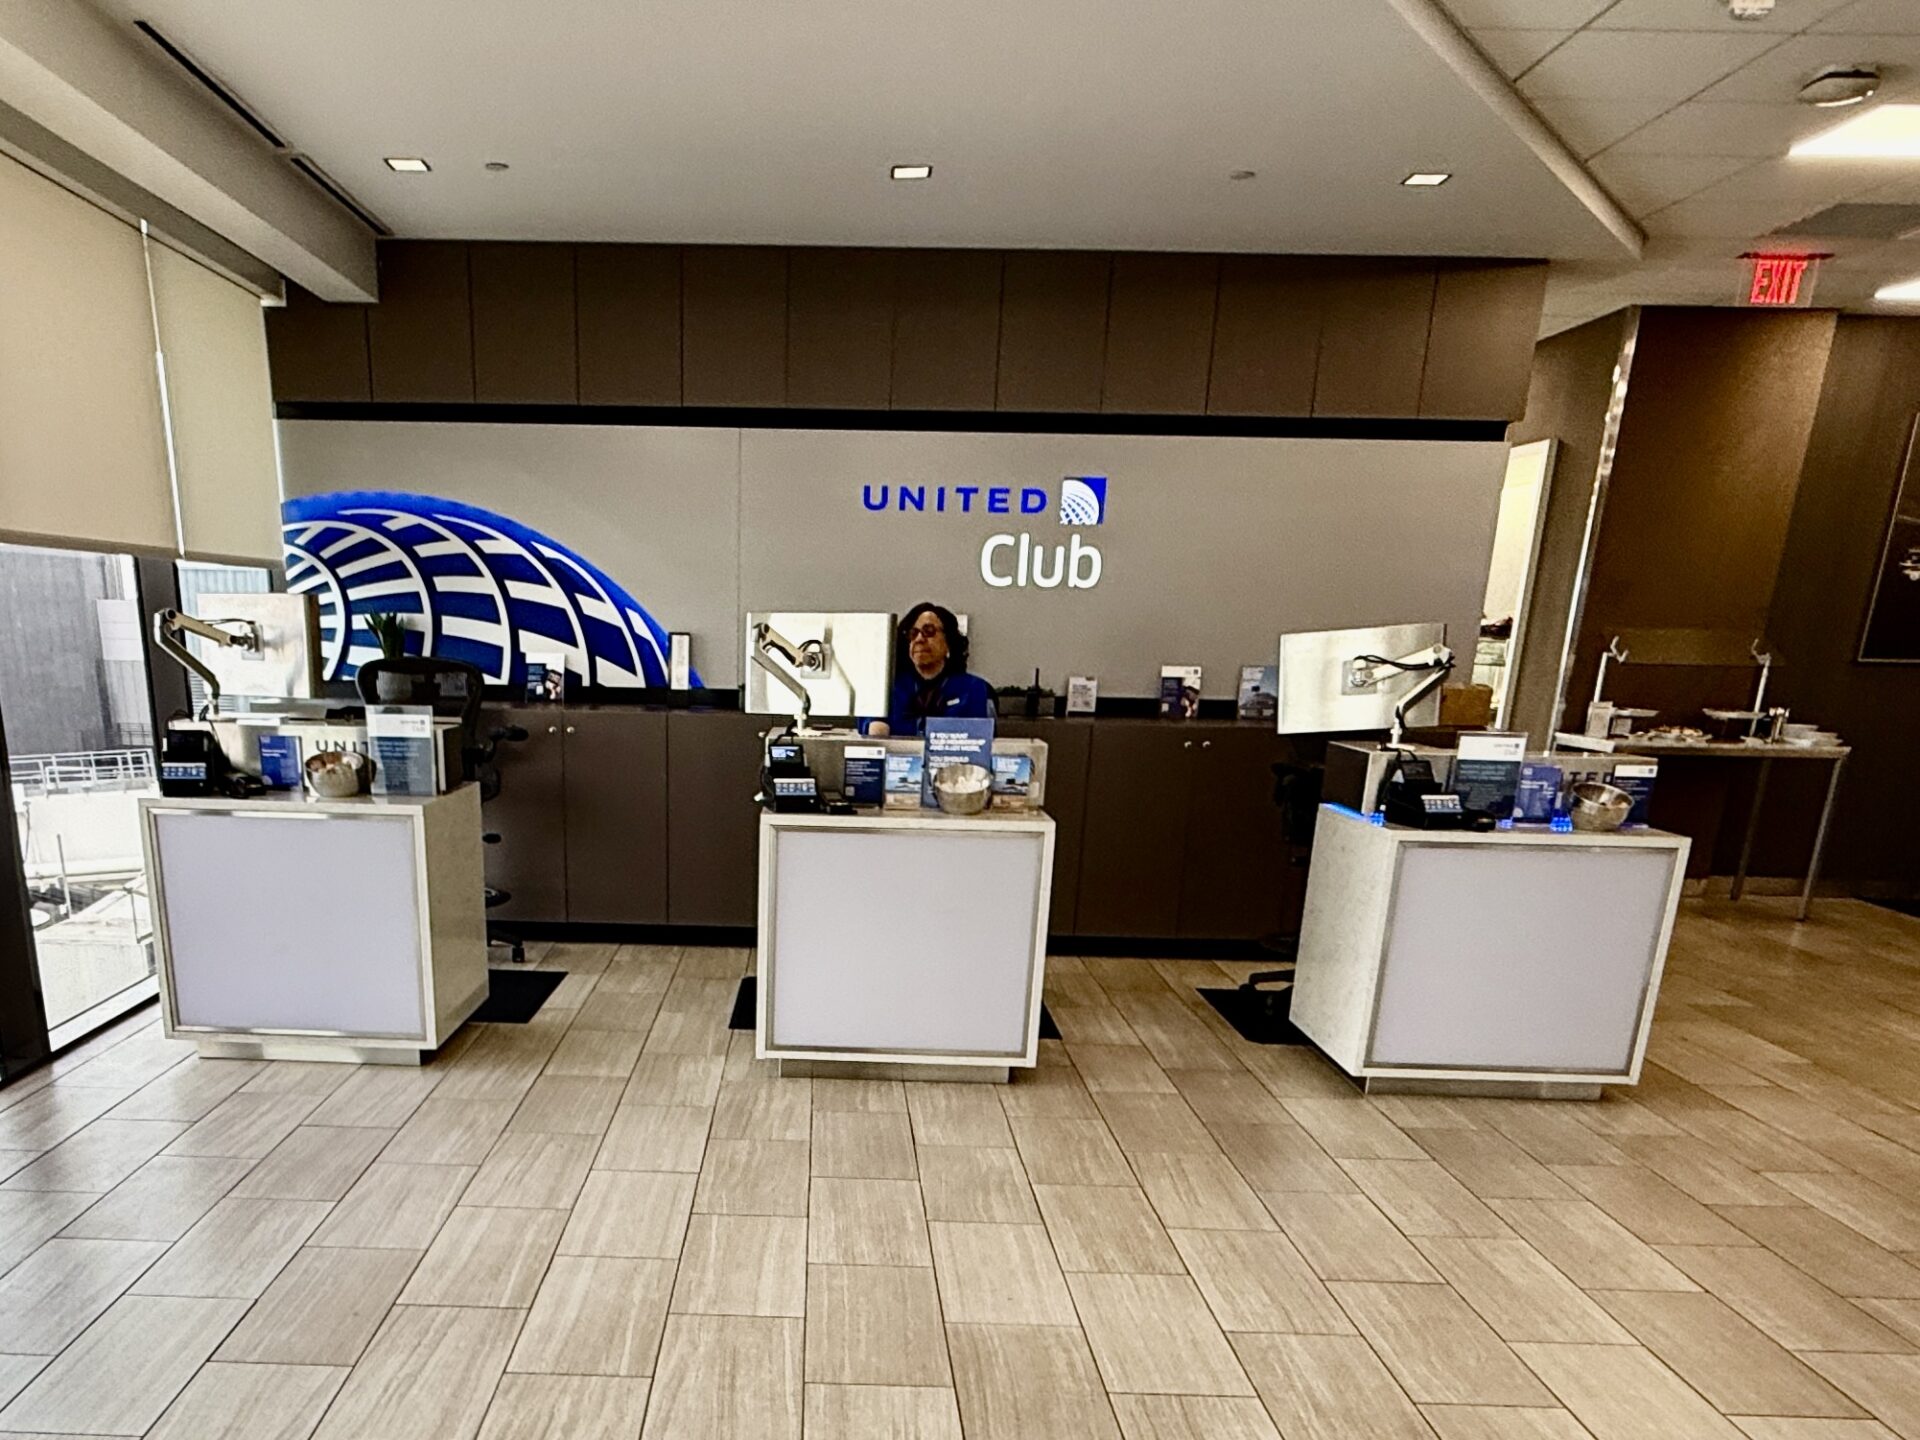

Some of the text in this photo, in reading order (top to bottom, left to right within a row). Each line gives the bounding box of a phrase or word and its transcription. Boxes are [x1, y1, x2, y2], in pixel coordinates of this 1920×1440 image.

[1750, 259, 1808, 304] EXIT
[863, 485, 1048, 514] UNITED
[980, 532, 1103, 589] Club
